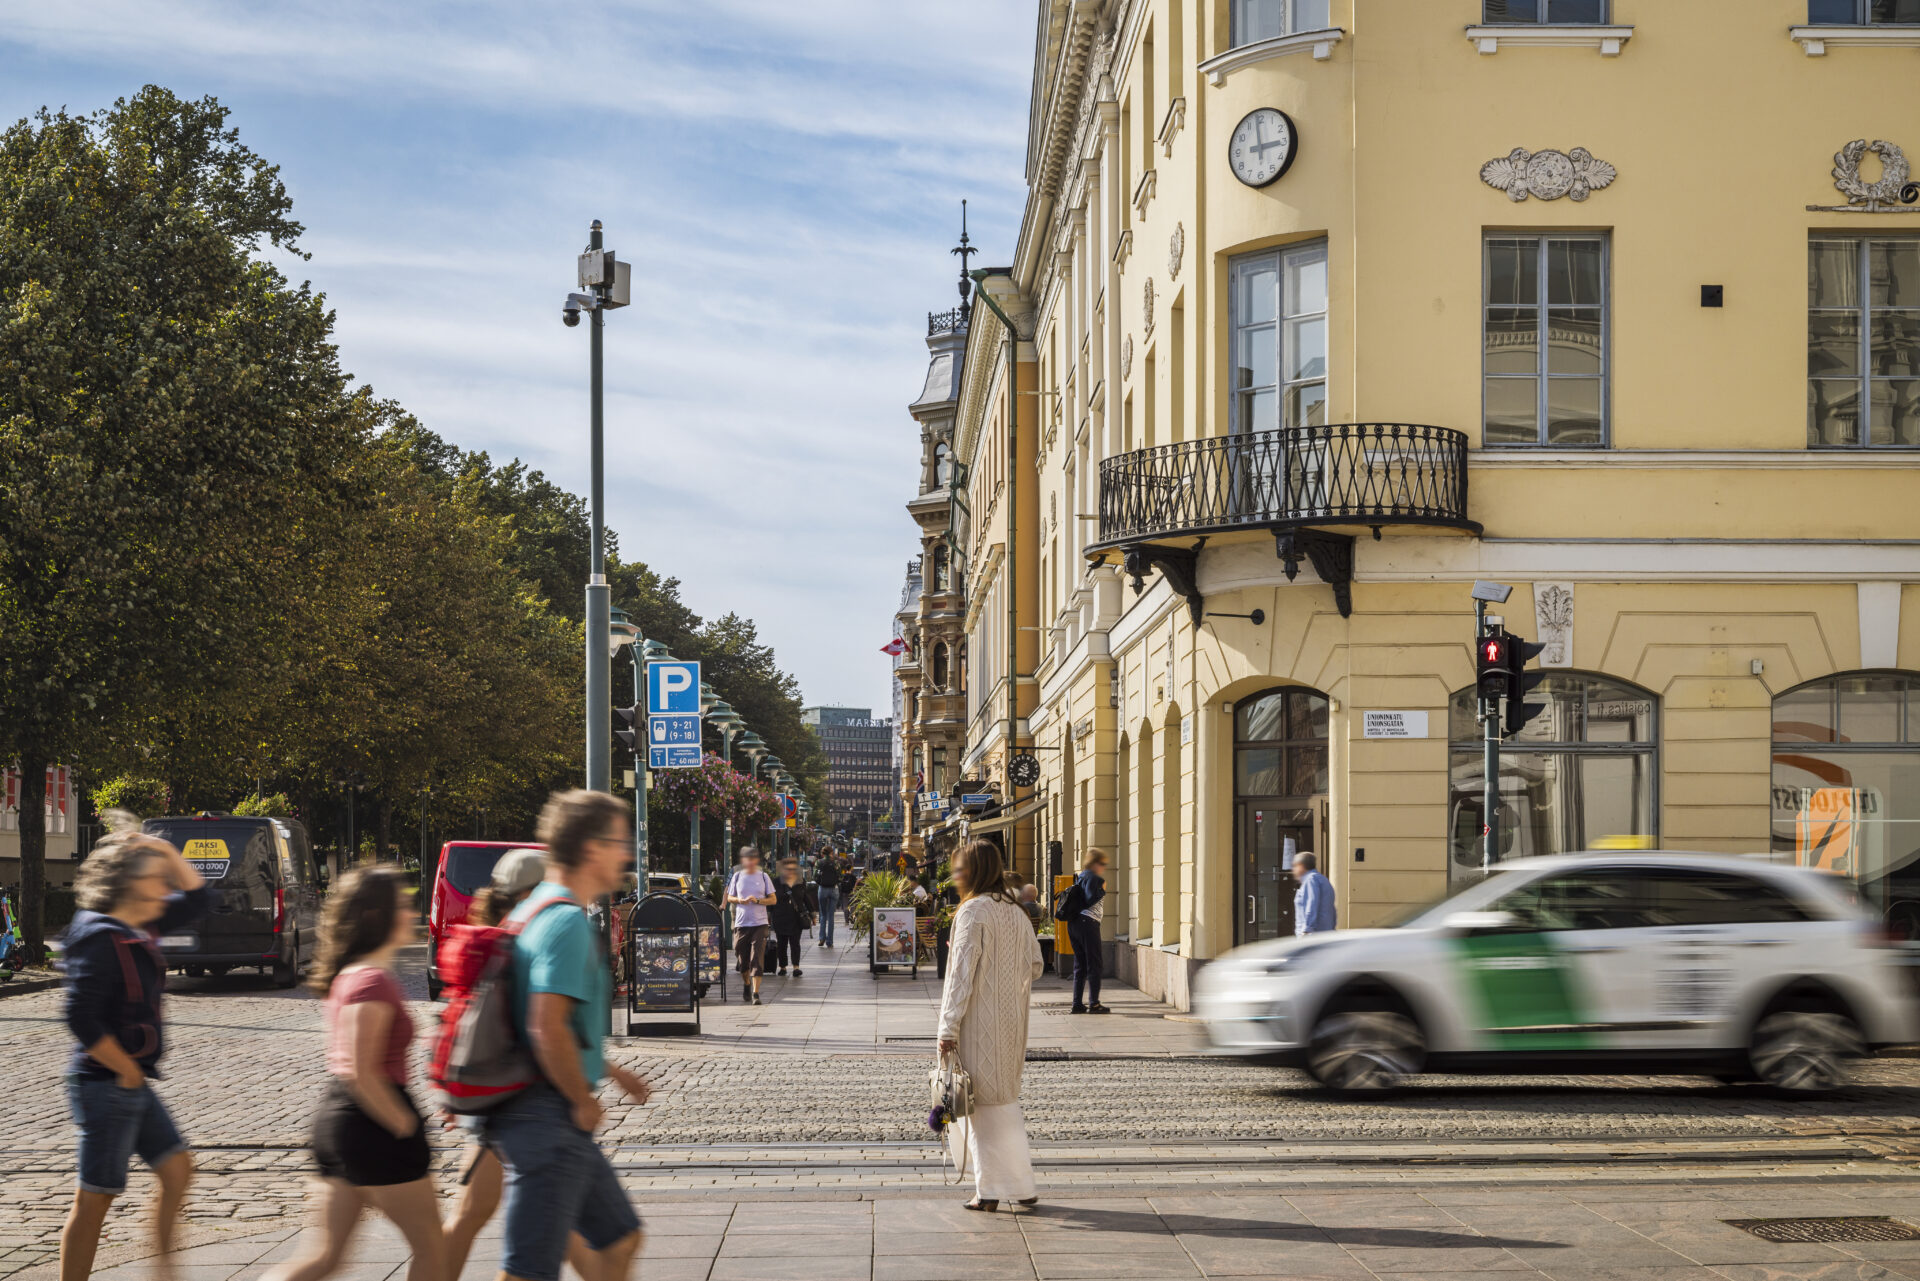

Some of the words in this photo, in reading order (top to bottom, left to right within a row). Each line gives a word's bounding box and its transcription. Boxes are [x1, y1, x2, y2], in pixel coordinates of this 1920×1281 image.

[1278, 125, 1284, 134] 2
[1235, 148, 1241, 158] 9
[1278, 152, 1284, 160] 4
[1238, 162, 1244, 170] 8
[1270, 164, 1276, 173] 5
[1248, 170, 1252, 178] 7
[1257, 171, 1264, 180] 6
[659, 666, 692, 709] P
[684, 721, 692, 729] 21
[670, 731, 678, 741] (9
[684, 731, 695, 741] 18)
